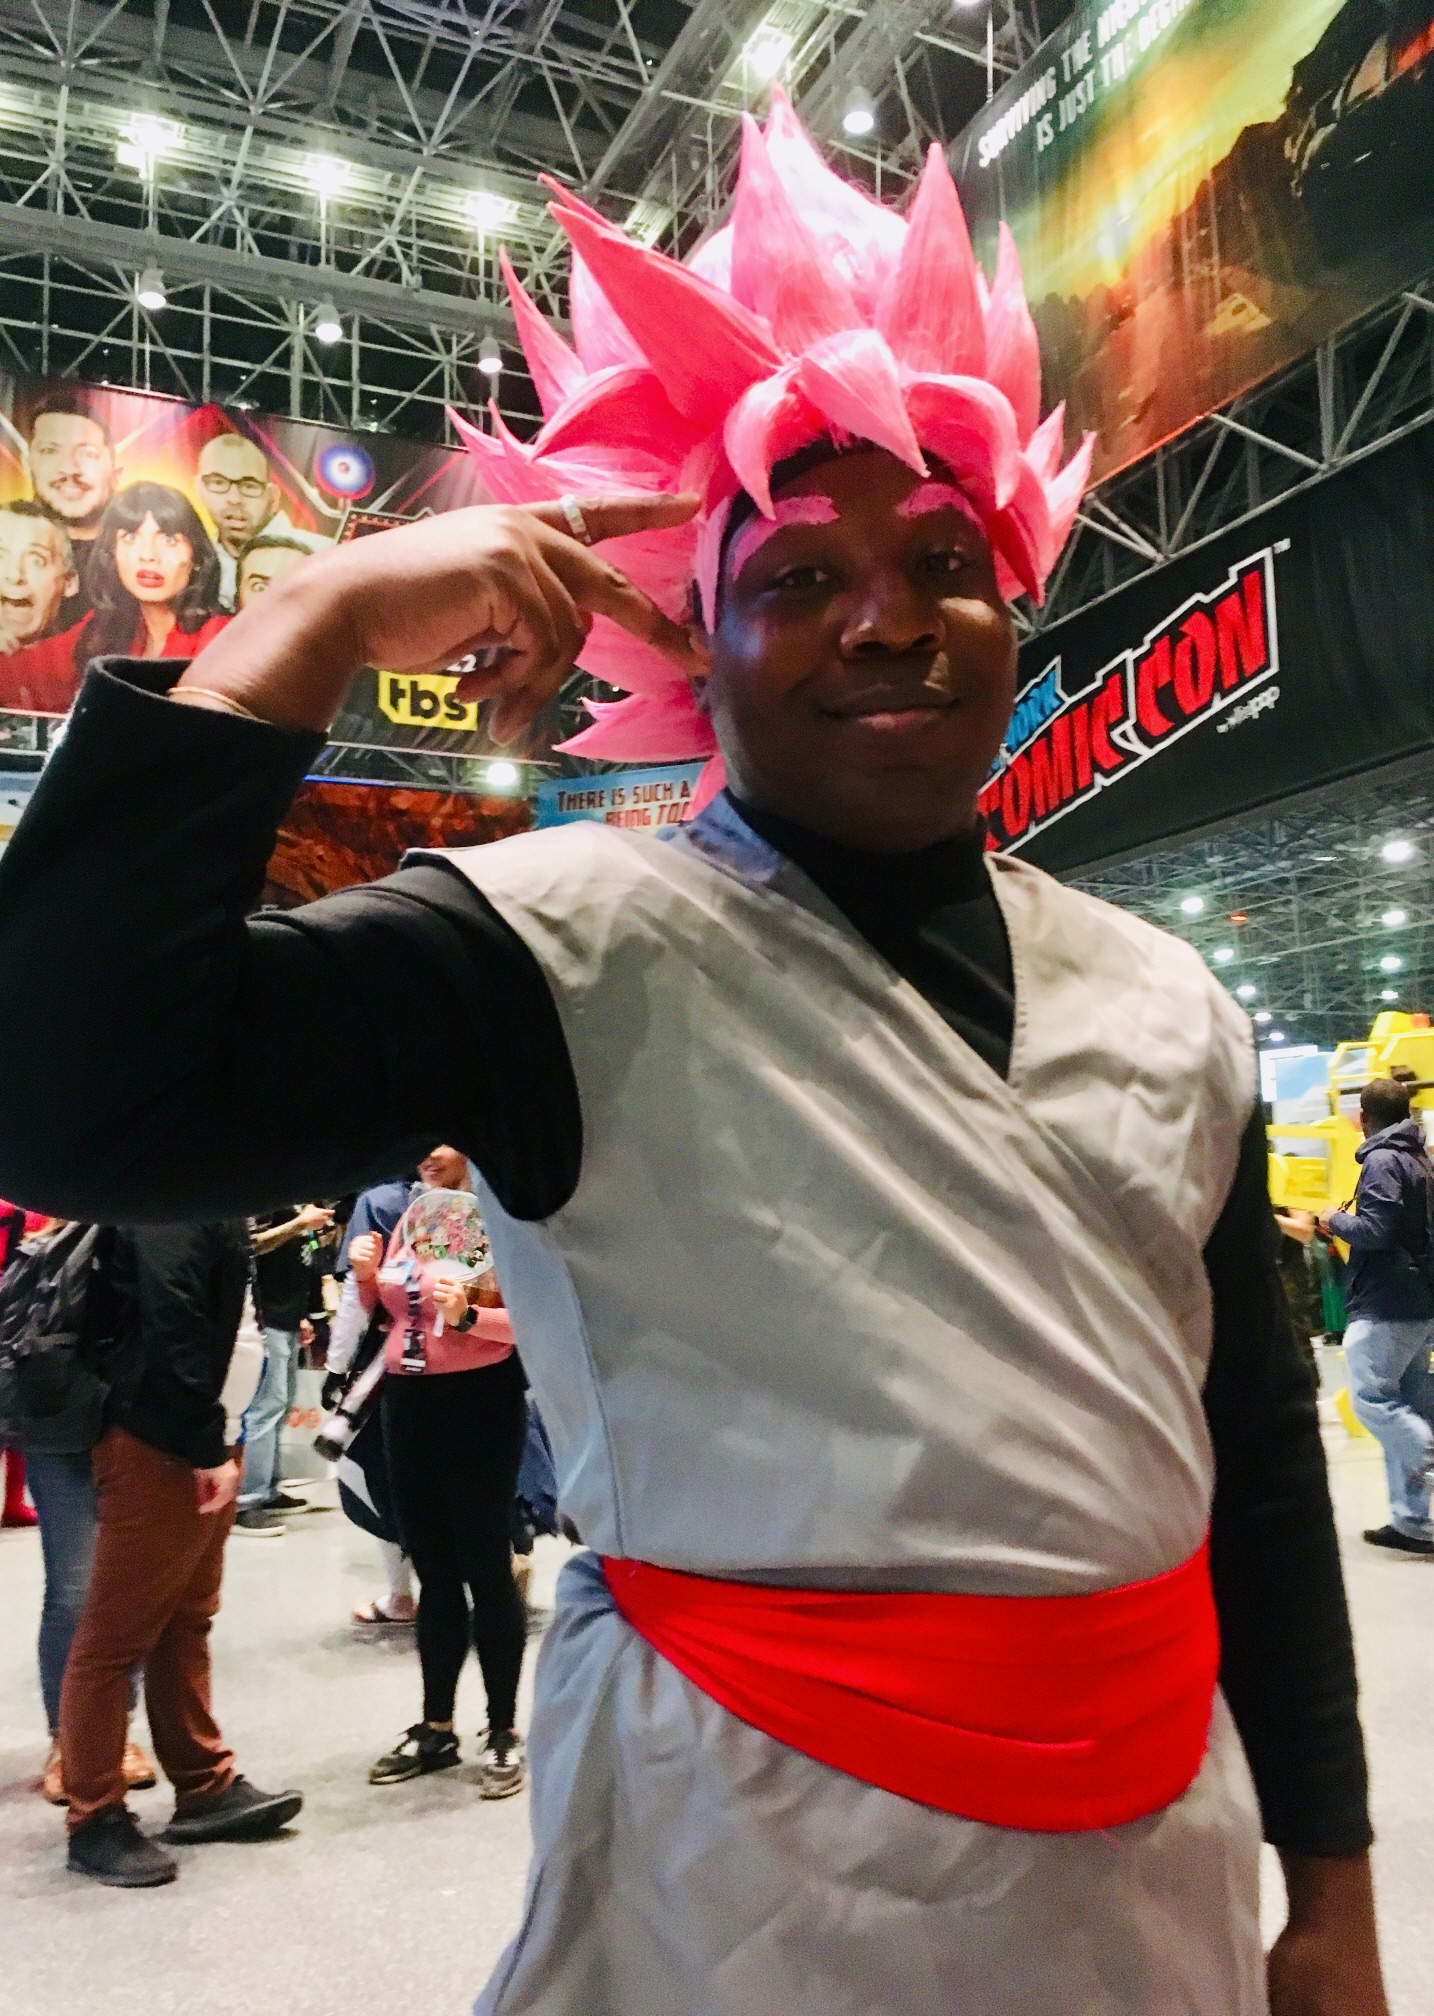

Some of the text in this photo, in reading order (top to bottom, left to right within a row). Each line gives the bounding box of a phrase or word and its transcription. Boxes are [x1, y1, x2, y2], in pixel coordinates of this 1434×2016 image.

[1060, 30, 1093, 83] THE
[1036, 112, 1055, 153] IS
[1058, 69, 1095, 132] JUST
[1100, 32, 1134, 88] THE
[1136, 569, 1267, 737] CON
[389, 677, 468, 722] tbs
[557, 780, 691, 812] THERE IS SUCH A
